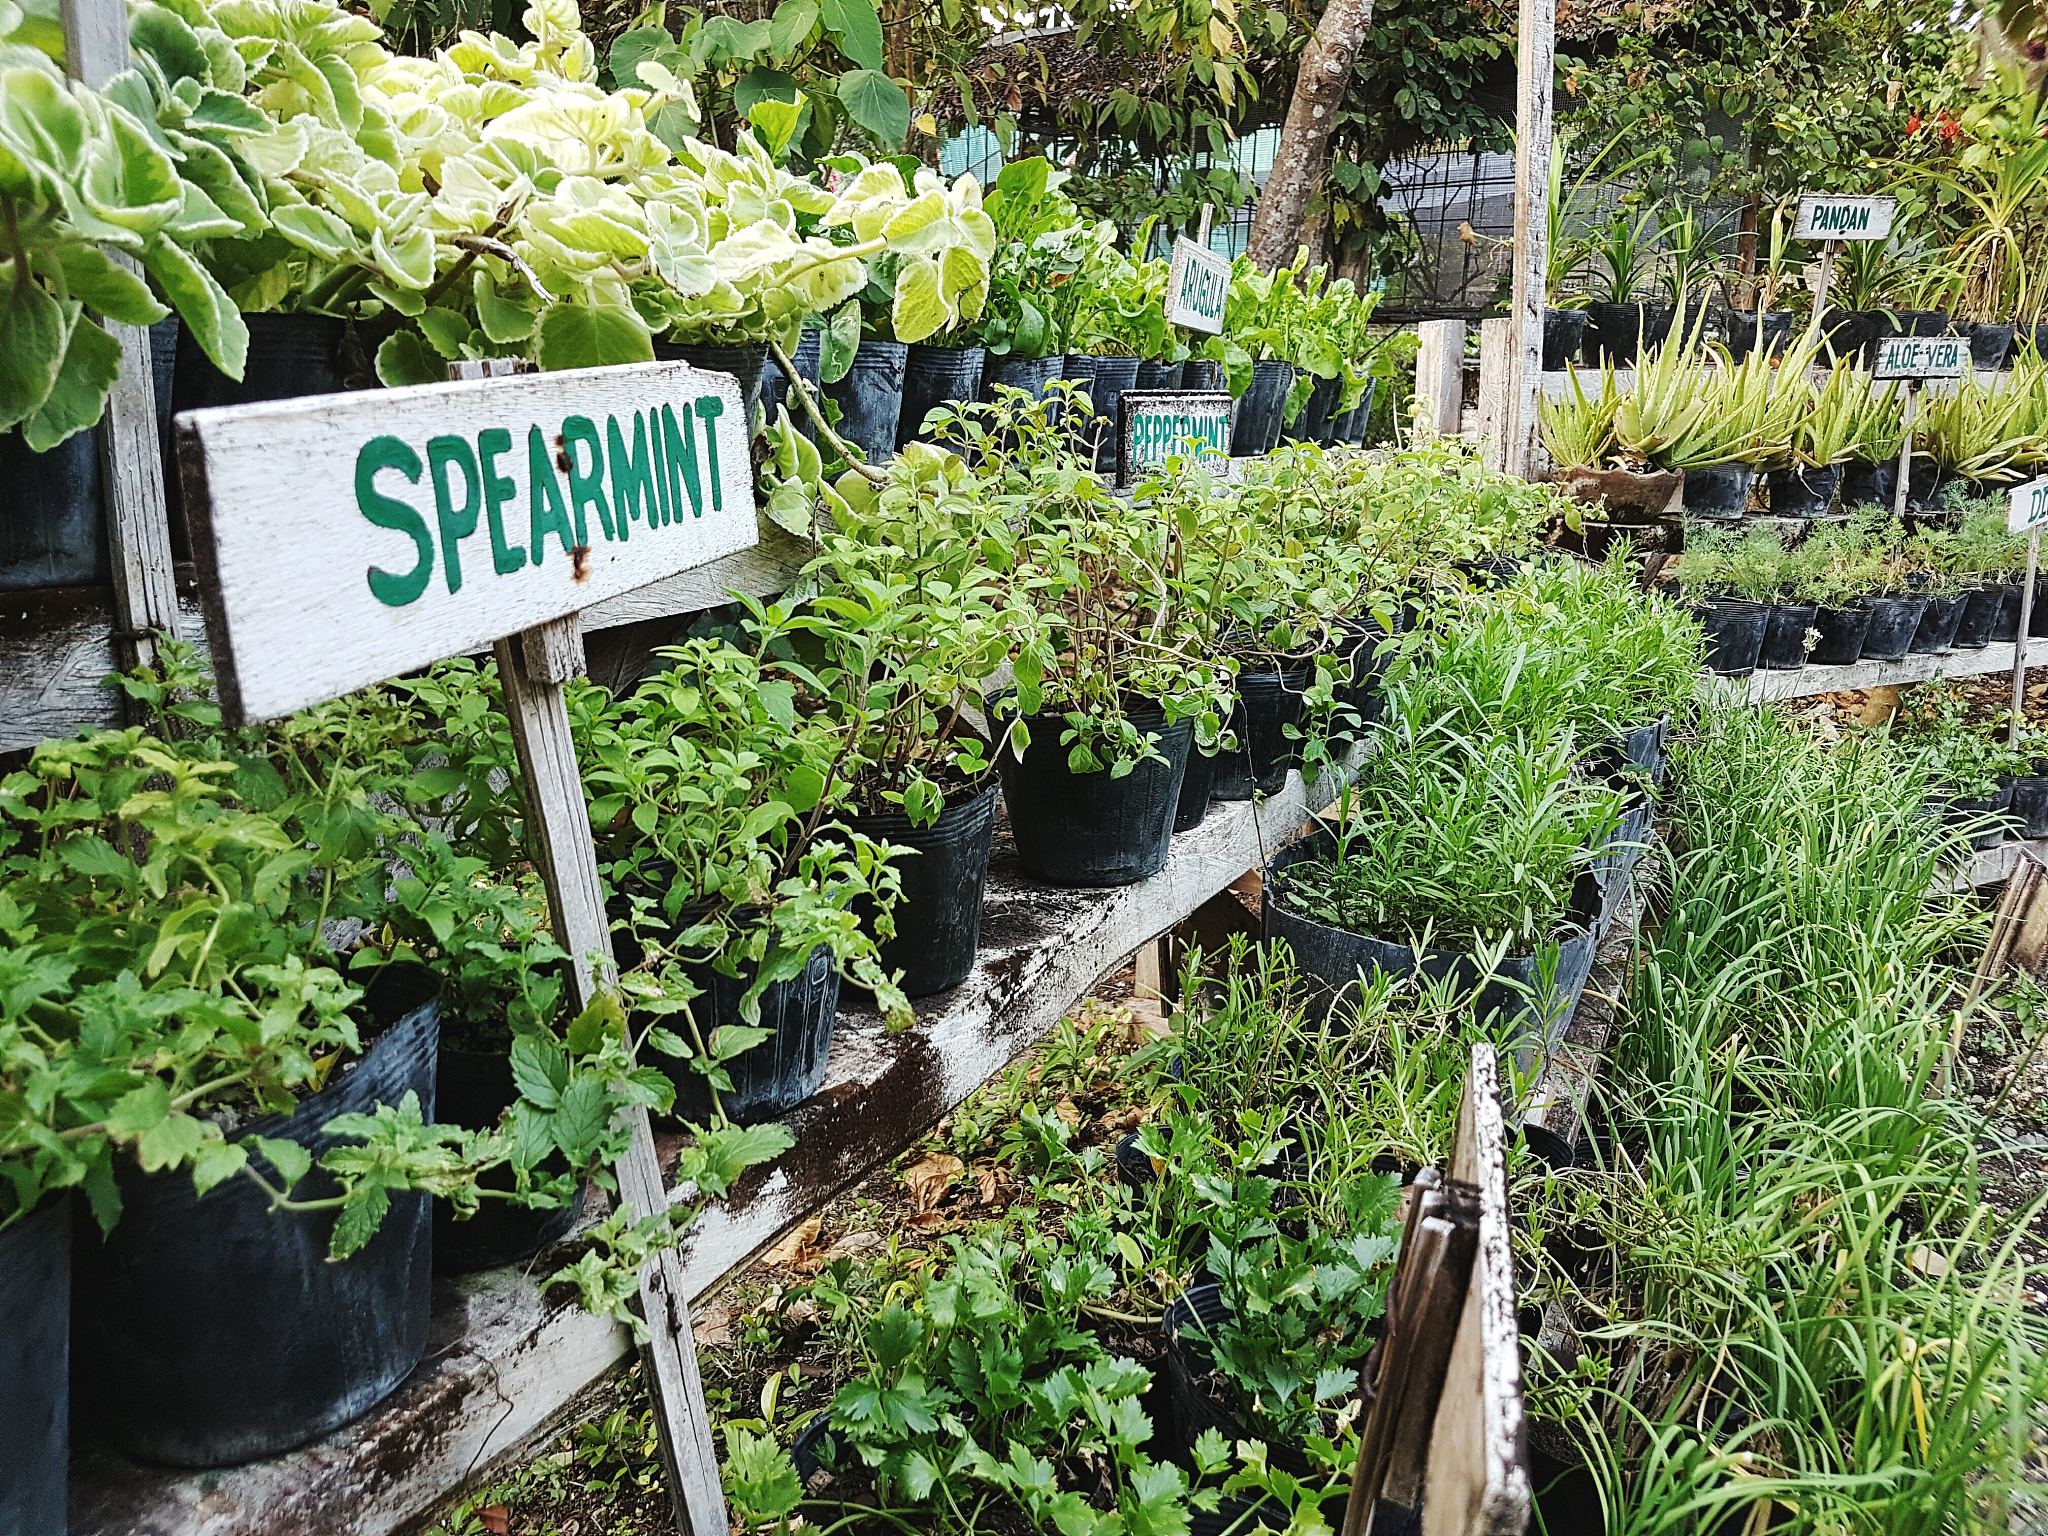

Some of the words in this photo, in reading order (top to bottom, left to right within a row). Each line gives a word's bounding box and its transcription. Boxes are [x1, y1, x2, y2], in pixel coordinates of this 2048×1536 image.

[1810, 204, 1871, 231] PANDAN
[1178, 256, 1224, 321] ARUGULA
[1884, 343, 1921, 371] ALOE
[1927, 343, 1959, 369] VERA
[1132, 413, 1229, 470] PEPPERMINT
[354, 395, 724, 607] SPEARMINT
